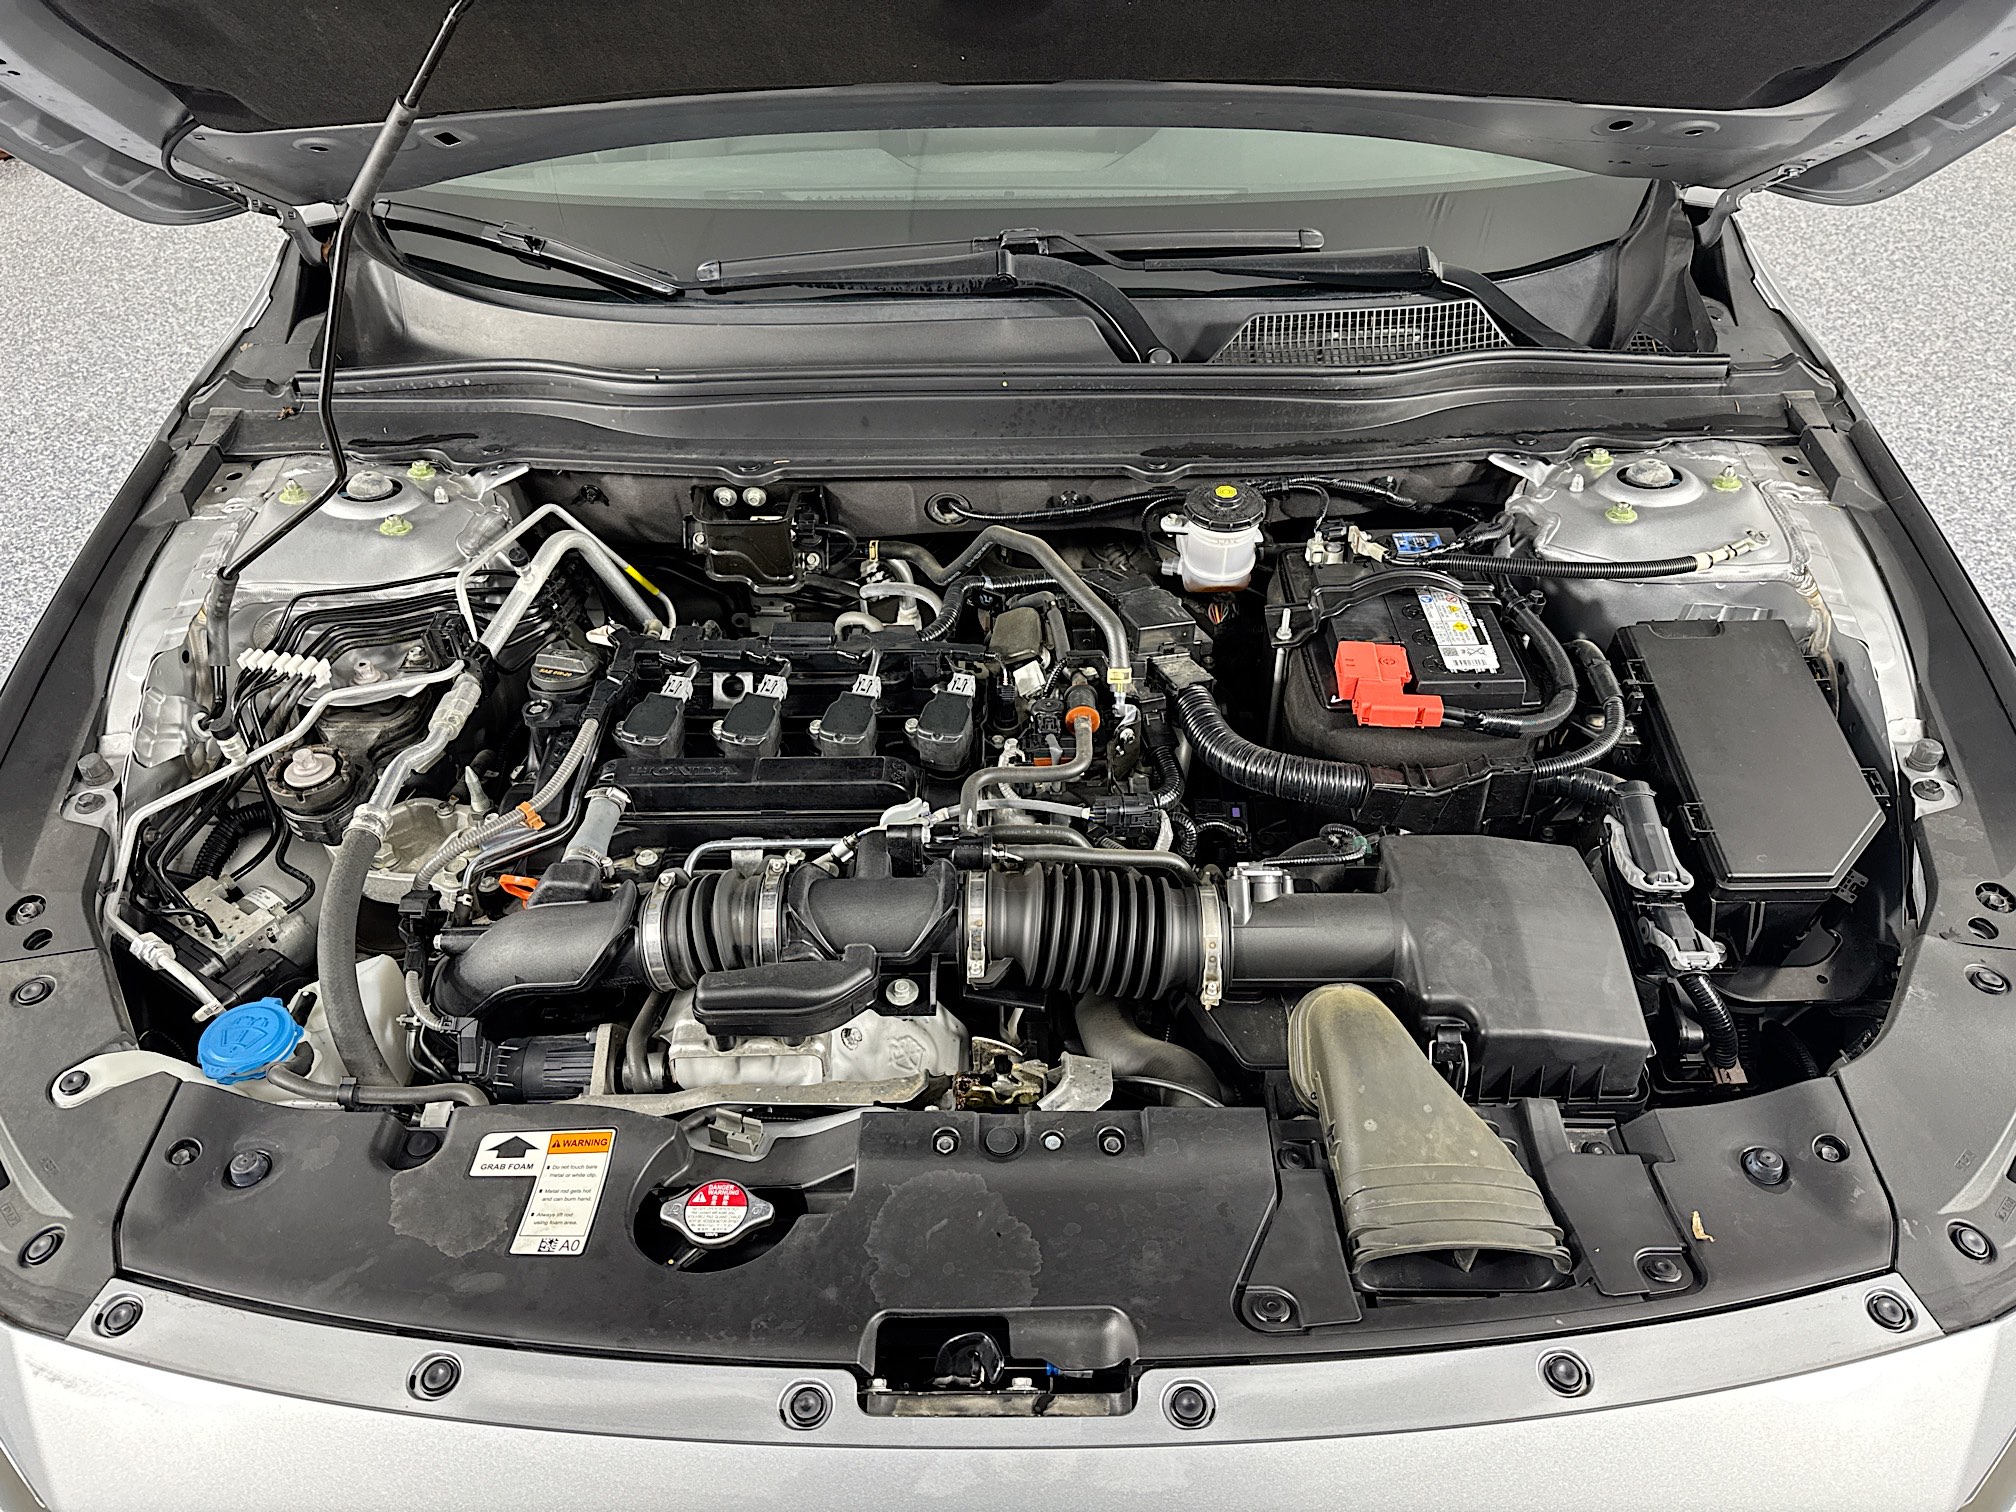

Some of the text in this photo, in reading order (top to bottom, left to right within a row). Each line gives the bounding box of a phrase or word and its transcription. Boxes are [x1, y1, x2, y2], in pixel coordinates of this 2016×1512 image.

[628, 765, 738, 777] HONDA
[562, 1138, 608, 1148] WARNING
[558, 1239, 581, 1251] A0
